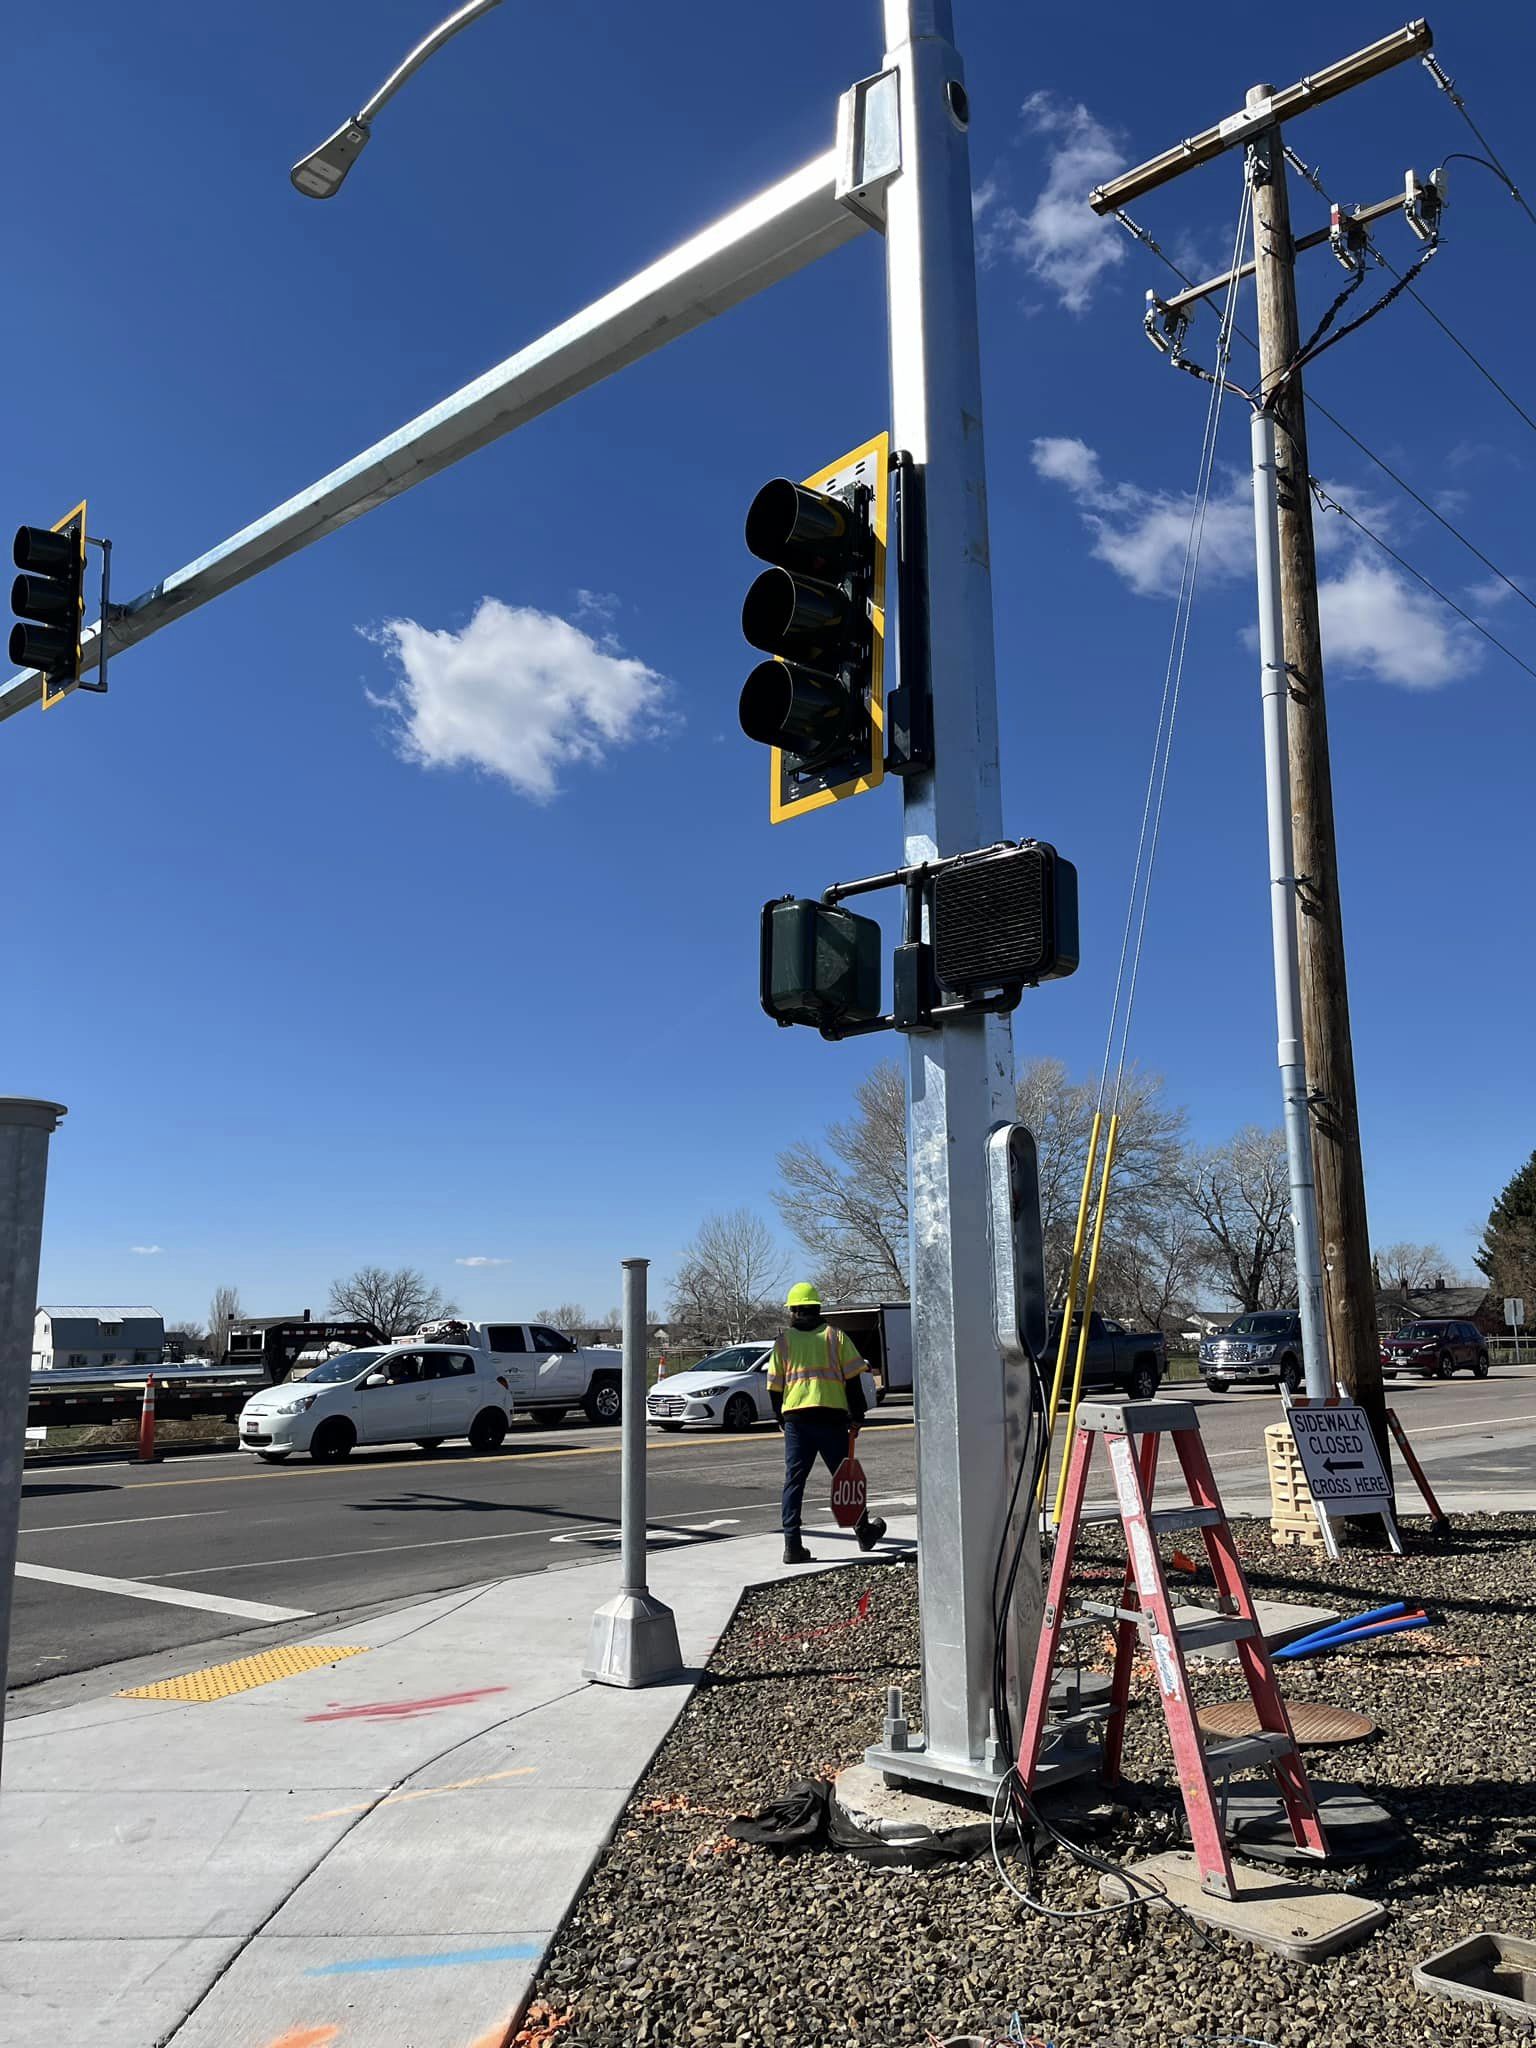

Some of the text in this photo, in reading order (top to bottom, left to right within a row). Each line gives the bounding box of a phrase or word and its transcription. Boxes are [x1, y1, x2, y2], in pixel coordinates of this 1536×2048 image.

[325, 1327, 338, 1336] PJ
[1294, 1413, 1365, 1433] SIDEWALK
[1309, 1435, 1363, 1455] CLOSED
[833, 1480, 865, 1505] STOP
[1312, 1476, 1387, 1495] CROSS HERE
